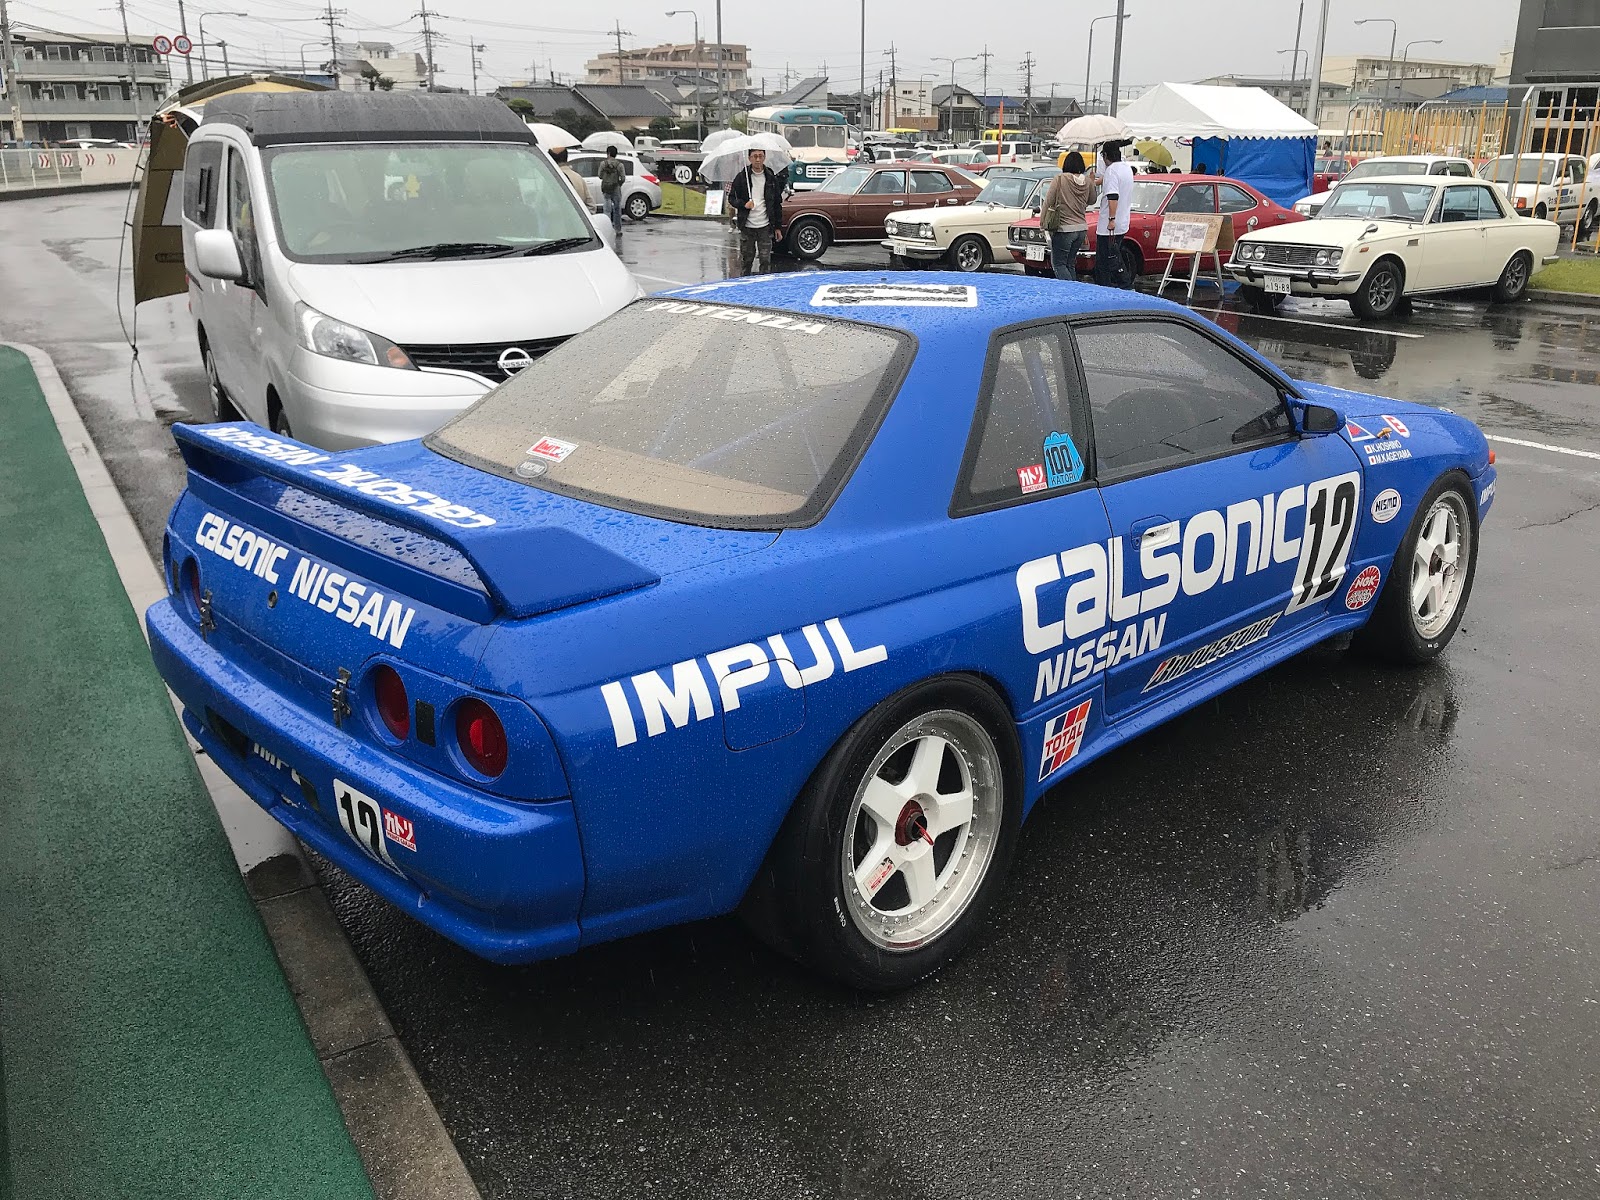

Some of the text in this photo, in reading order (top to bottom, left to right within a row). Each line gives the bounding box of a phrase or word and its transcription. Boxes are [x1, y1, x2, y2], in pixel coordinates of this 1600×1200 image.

[178, 40, 188, 50] 40
[678, 169, 690, 180] 40
[644, 302, 826, 334] POTENZA
[1046, 445, 1073, 475] 100
[1020, 466, 1043, 487] カトリ
[1375, 497, 1397, 512] NISMO
[1297, 481, 1356, 607] 12
[1355, 575, 1376, 589] NGK
[288, 557, 416, 650] NISSAN
[1033, 613, 1167, 702] NISSAN
[600, 617, 889, 748] IMPUL
[1045, 721, 1083, 758] TOTAL
[385, 812, 413, 841] カトリ
